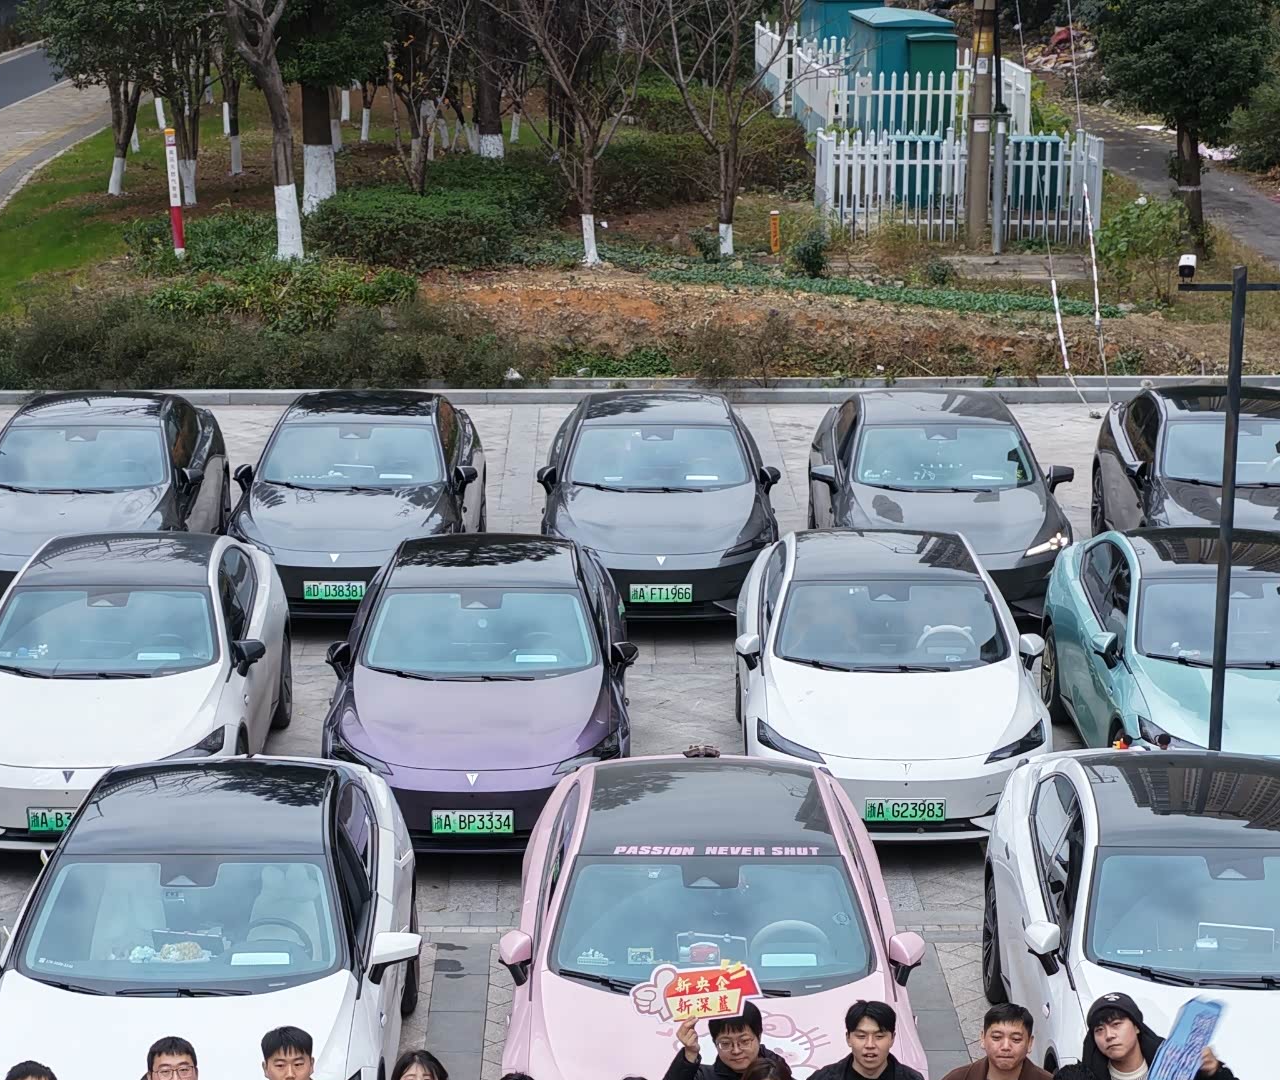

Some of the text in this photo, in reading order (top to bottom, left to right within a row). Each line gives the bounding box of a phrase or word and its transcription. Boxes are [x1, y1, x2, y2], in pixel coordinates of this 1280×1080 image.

[613, 846, 819, 856] PASSION NEVER SHUT
[674, 975, 730, 995] 新央企
[676, 994, 731, 1015] 新深蓝
